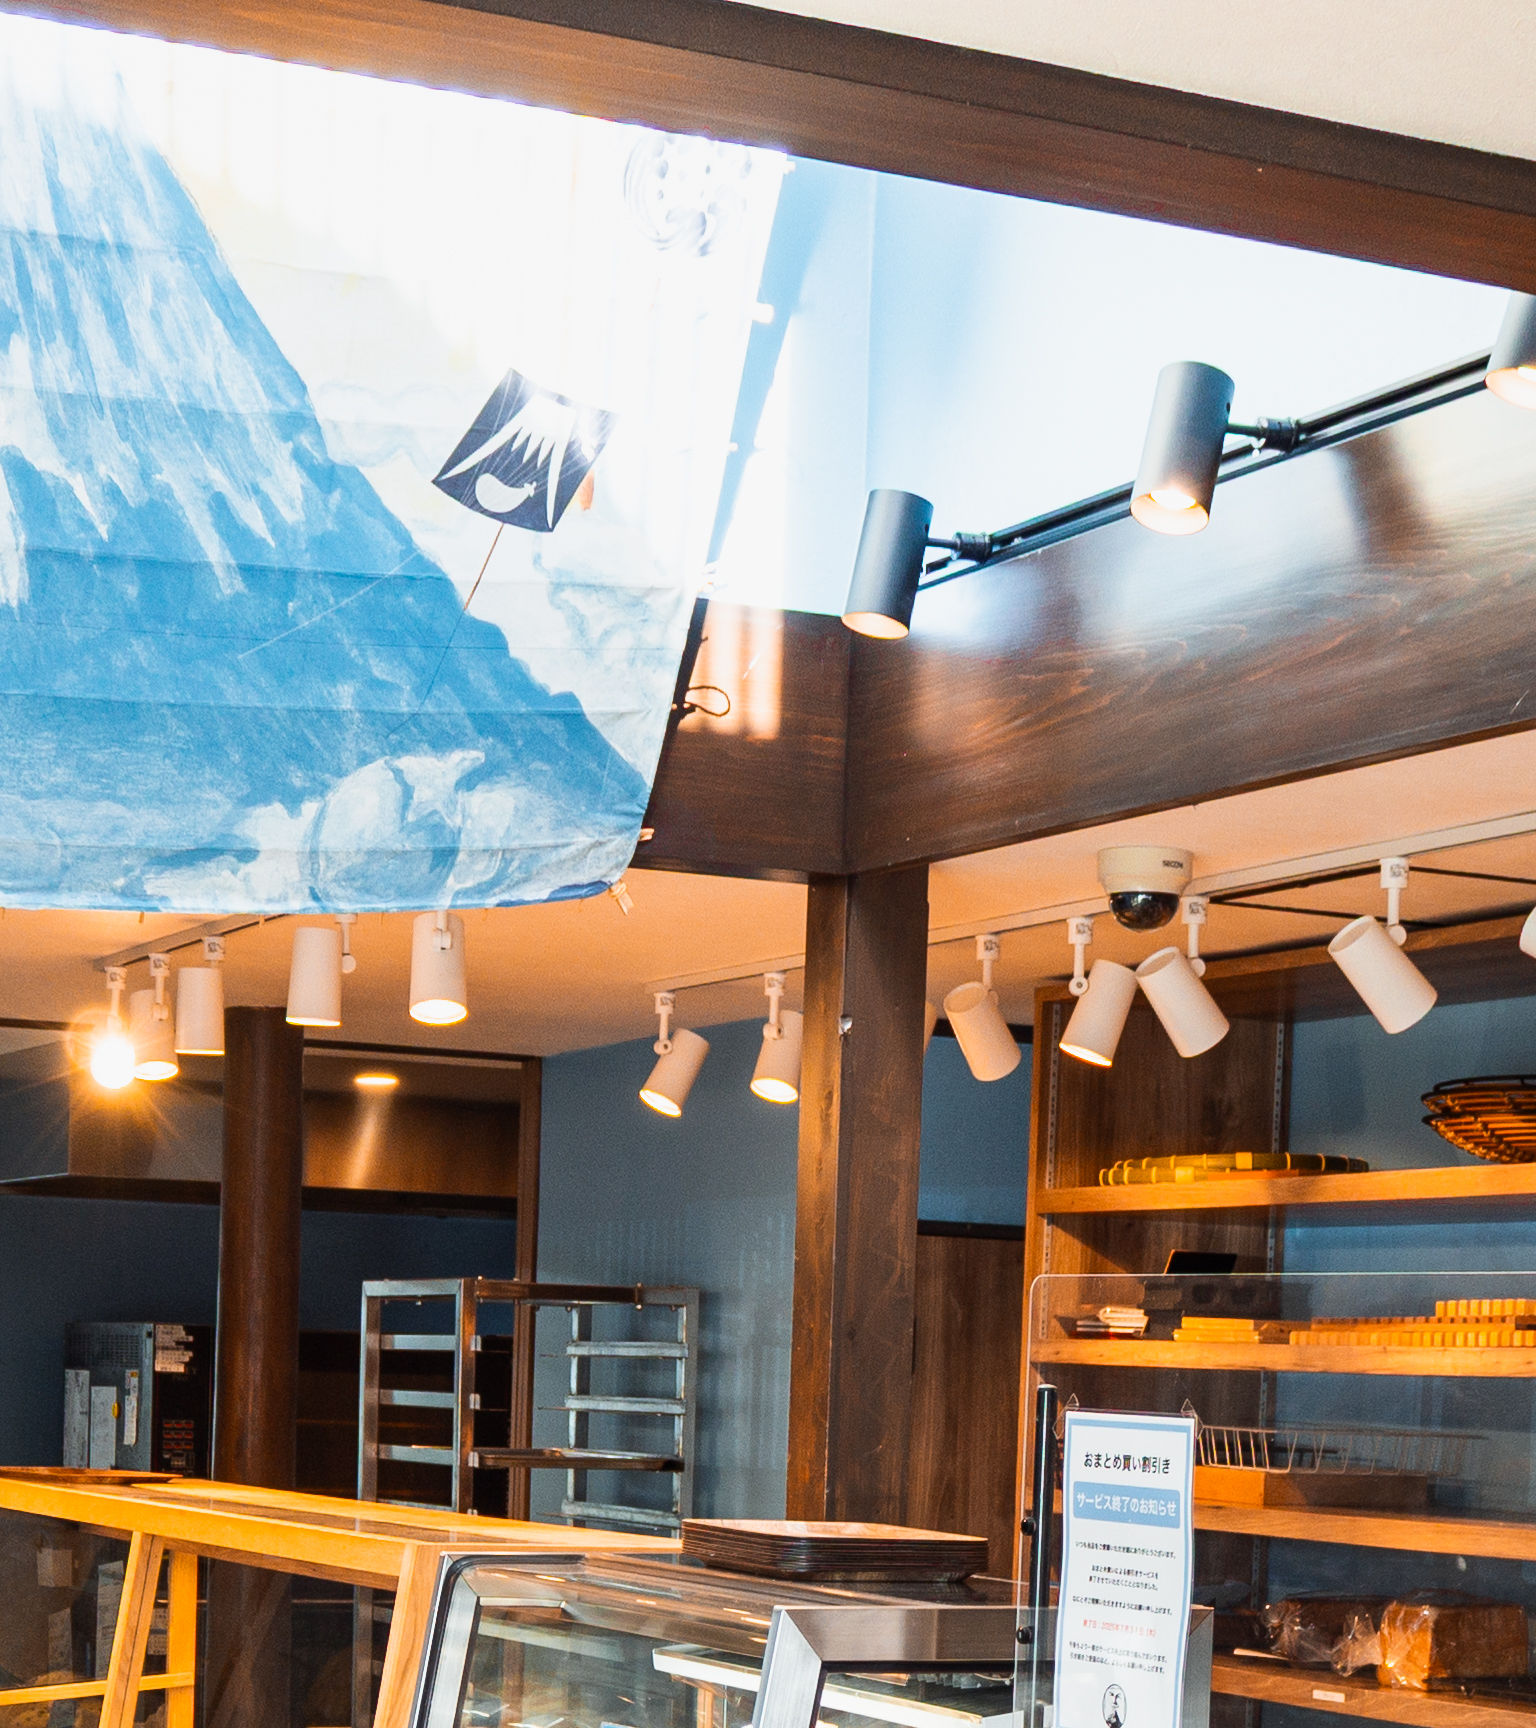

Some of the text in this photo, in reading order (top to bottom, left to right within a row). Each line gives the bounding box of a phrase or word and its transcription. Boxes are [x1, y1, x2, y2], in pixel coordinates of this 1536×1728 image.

[1083, 1452, 1171, 1474] おまとめ買い割引き
[1076, 1492, 1177, 1517] サービス終了のお知らせ
